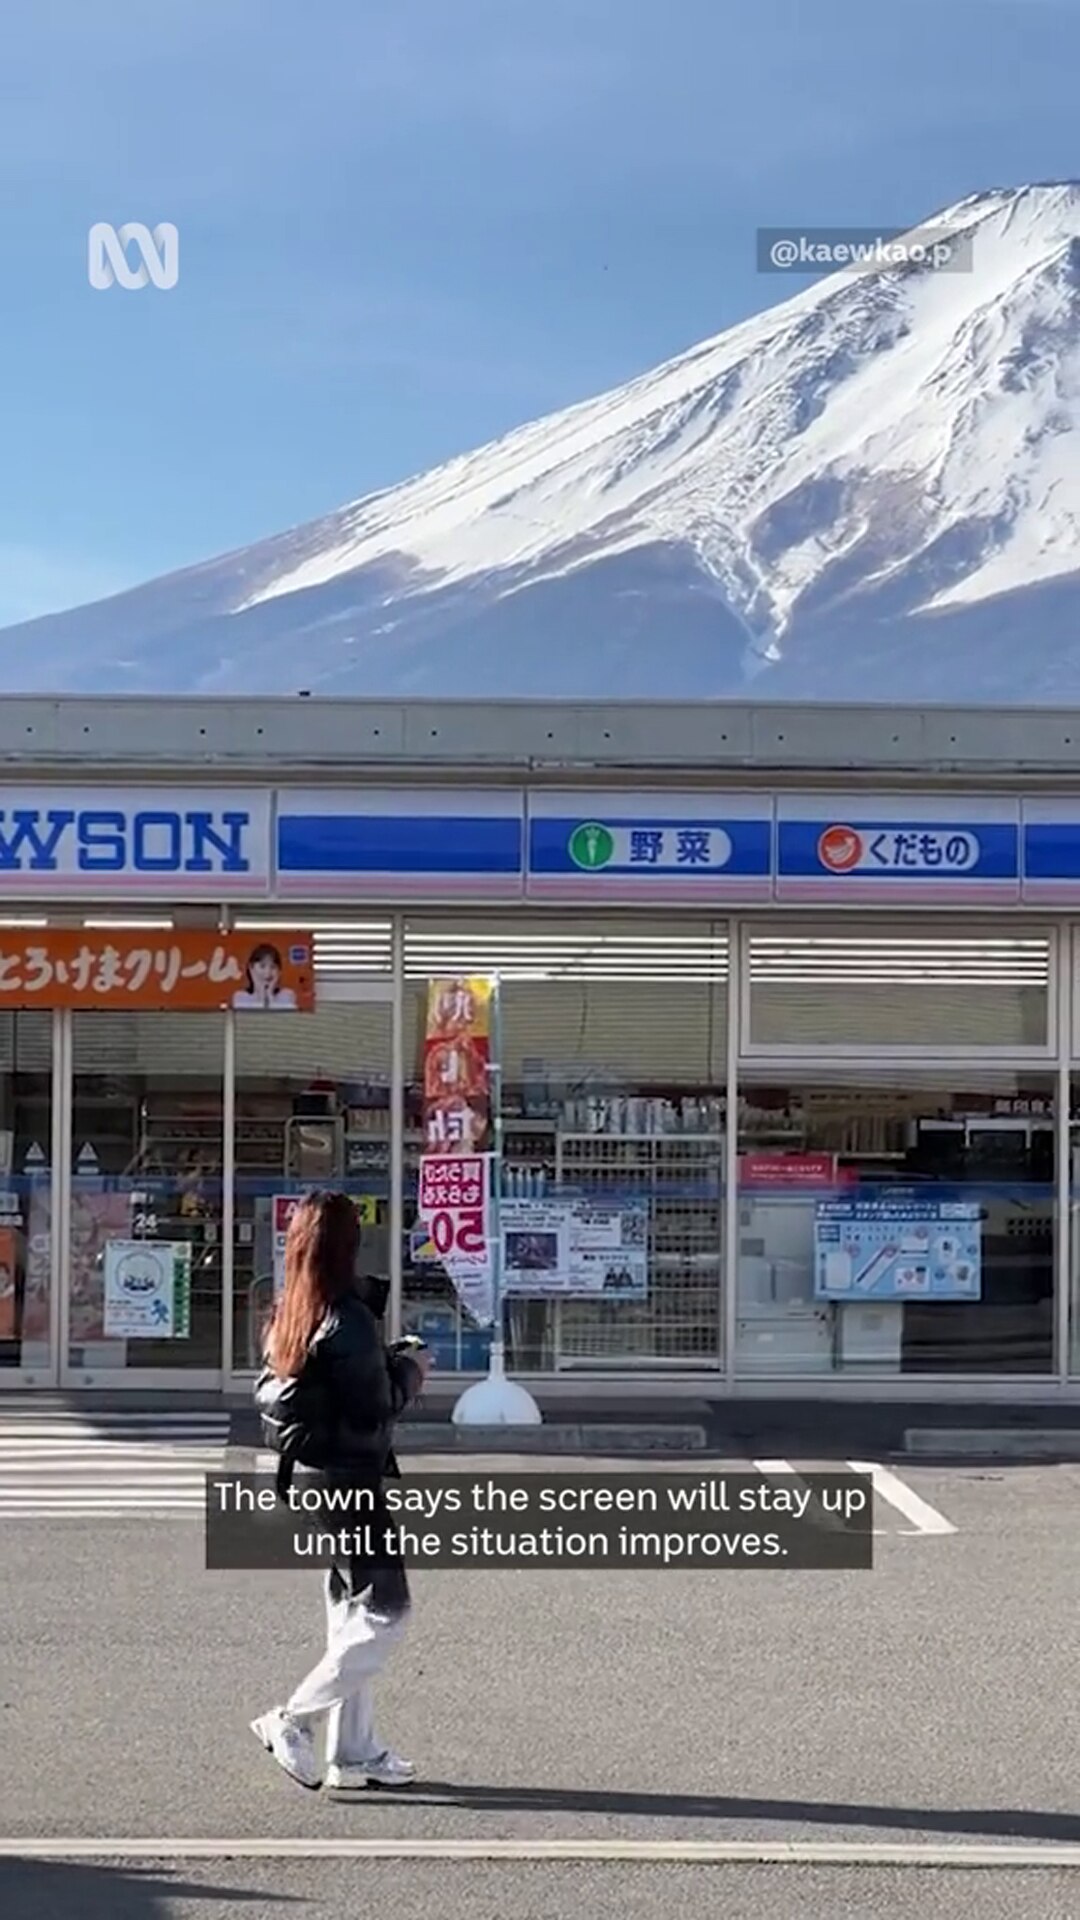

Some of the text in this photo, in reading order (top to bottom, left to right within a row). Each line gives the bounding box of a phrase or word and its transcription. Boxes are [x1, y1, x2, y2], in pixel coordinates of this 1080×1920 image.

[630, 831, 711, 865] 野菜
[869, 833, 970, 866] くだもの
